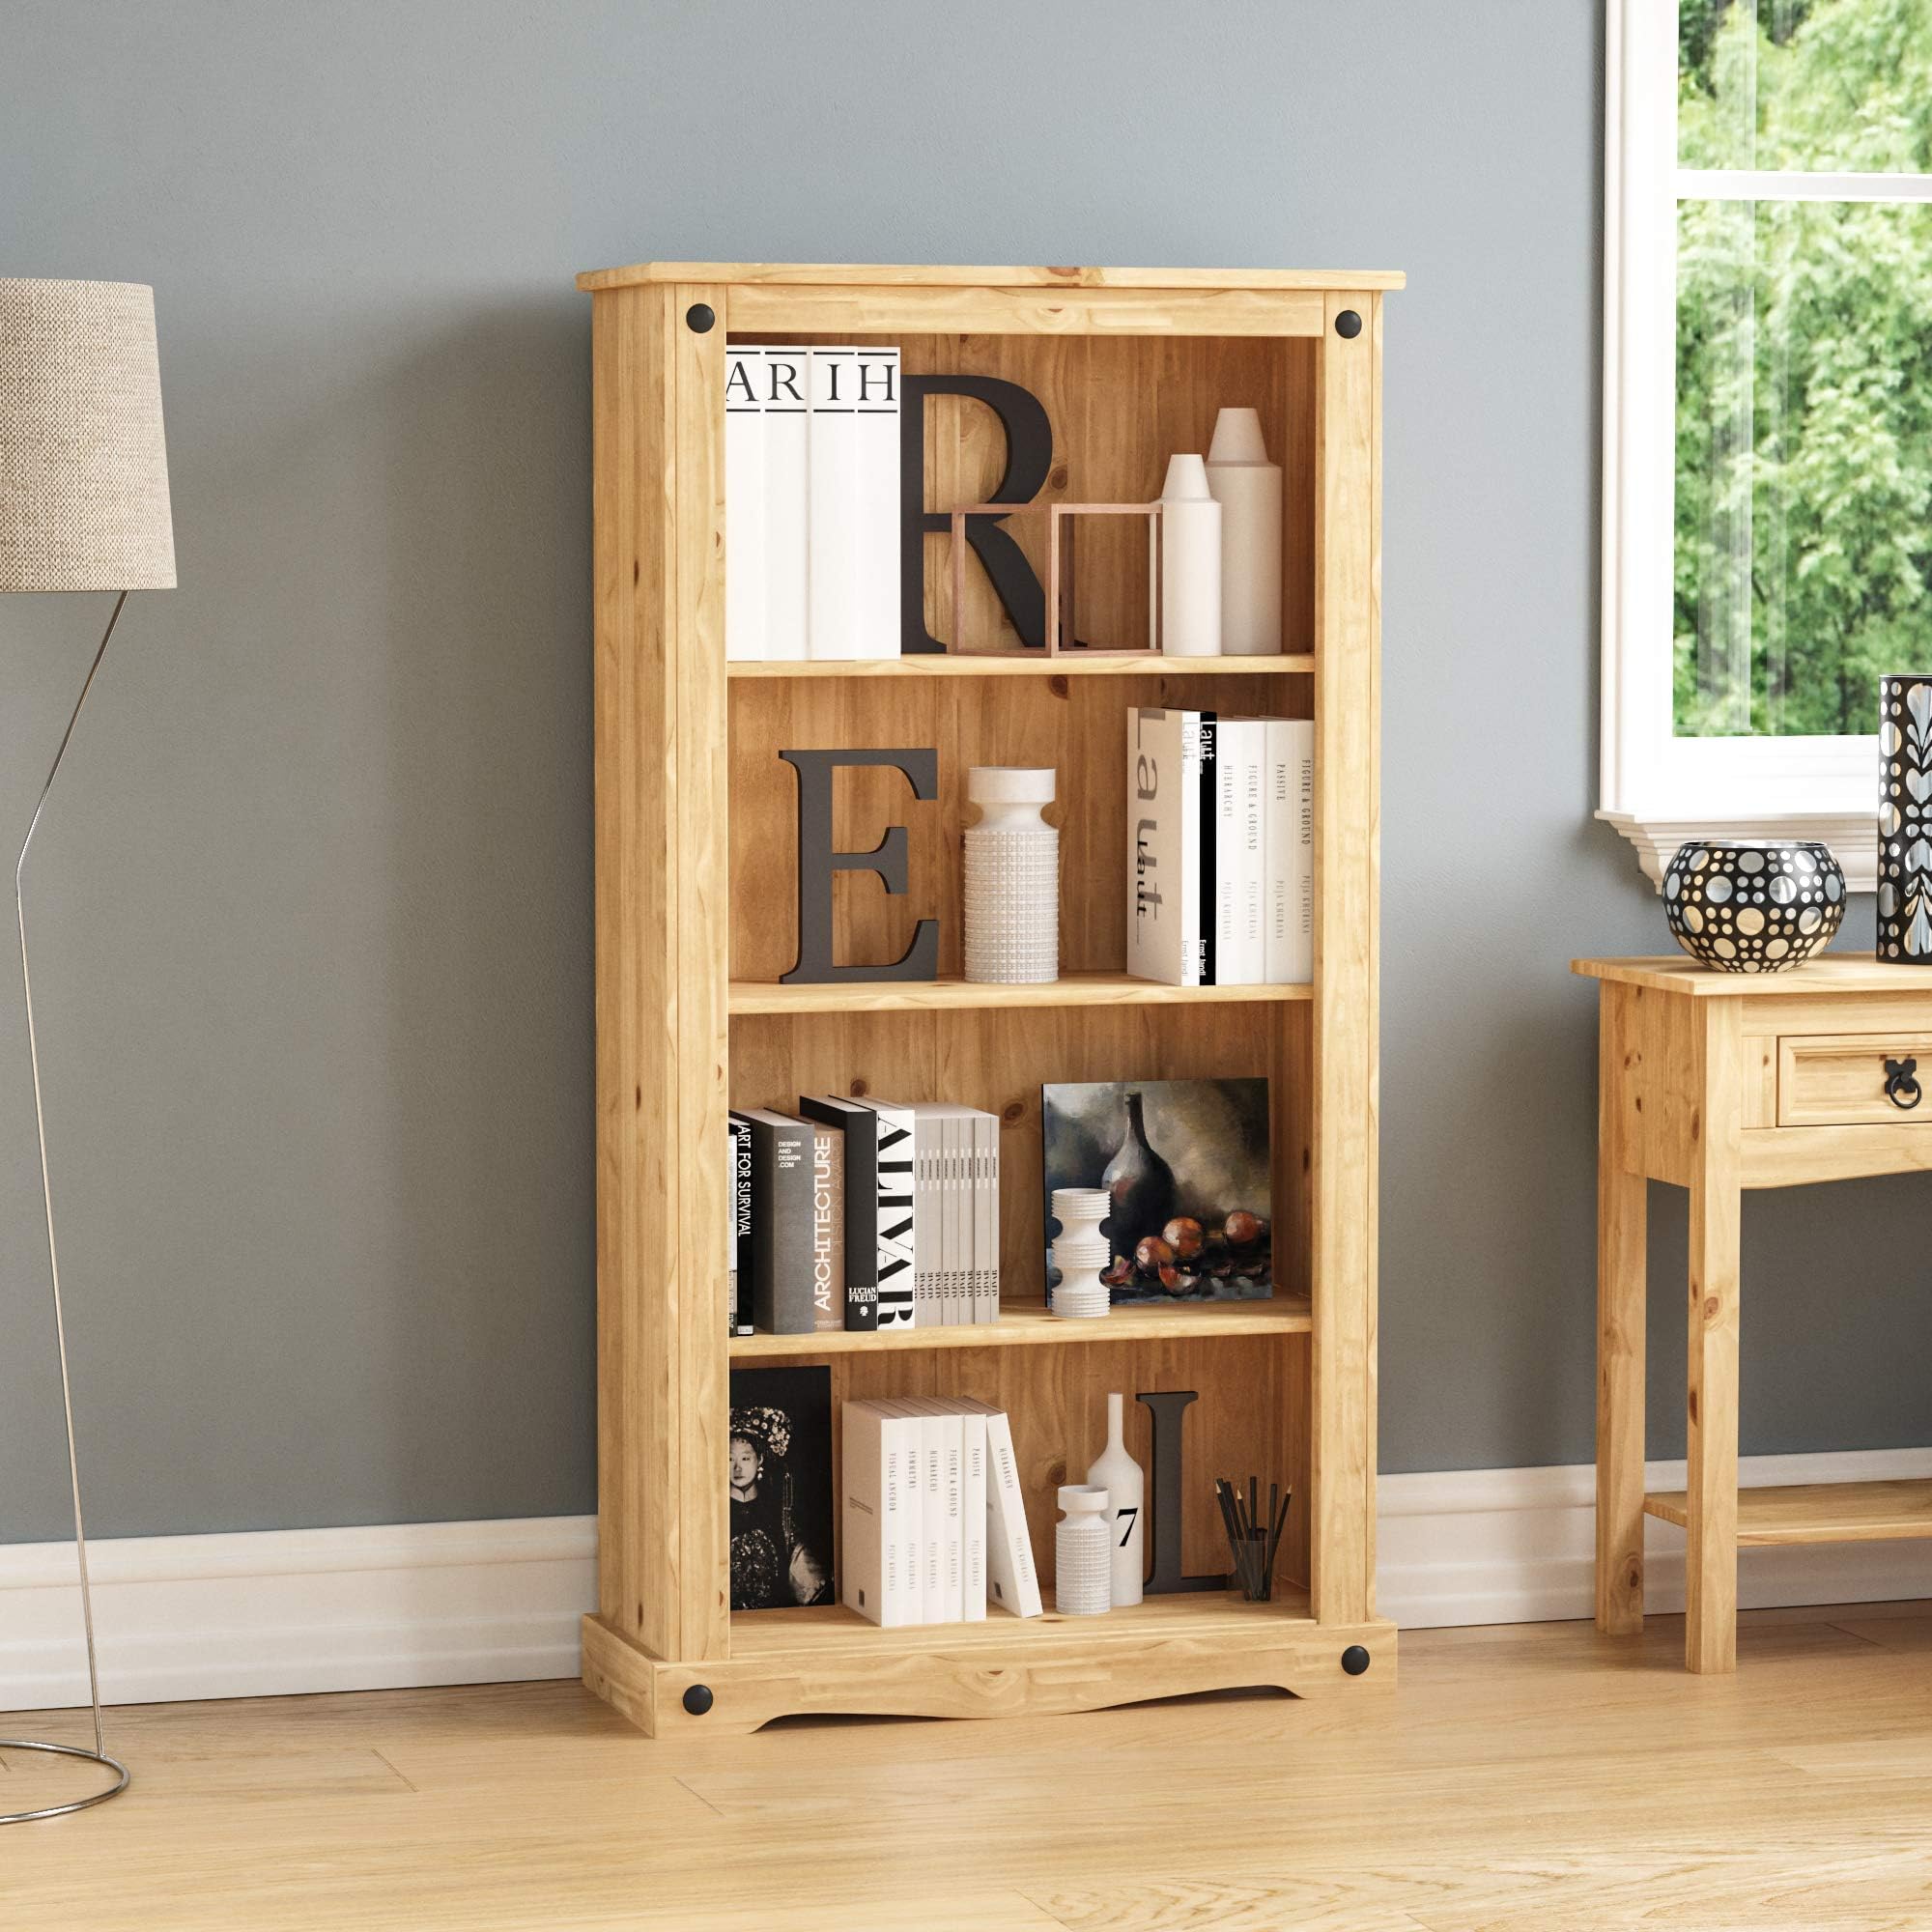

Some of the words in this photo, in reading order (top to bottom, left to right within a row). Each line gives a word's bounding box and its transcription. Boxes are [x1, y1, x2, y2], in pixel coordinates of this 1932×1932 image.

[1224, 766, 1233, 818] HIERARCHY
[1248, 765, 1257, 798] FIGURE
[1276, 764, 1285, 801] PASSIVE
[1248, 814, 1257, 850] GROUND
[779, 749, 939, 984] E
[738, 1125, 751, 1148] ART
[738, 1153, 751, 1178] FOR
[738, 1181, 751, 1236] SURVIVAL
[814, 1137, 830, 1311] ARCHITECTURE
[878, 1113, 913, 1328] ALIVAR
[1000, 1448, 1012, 1490] HIERARCHY
[1117, 1507, 1138, 1547] 7
